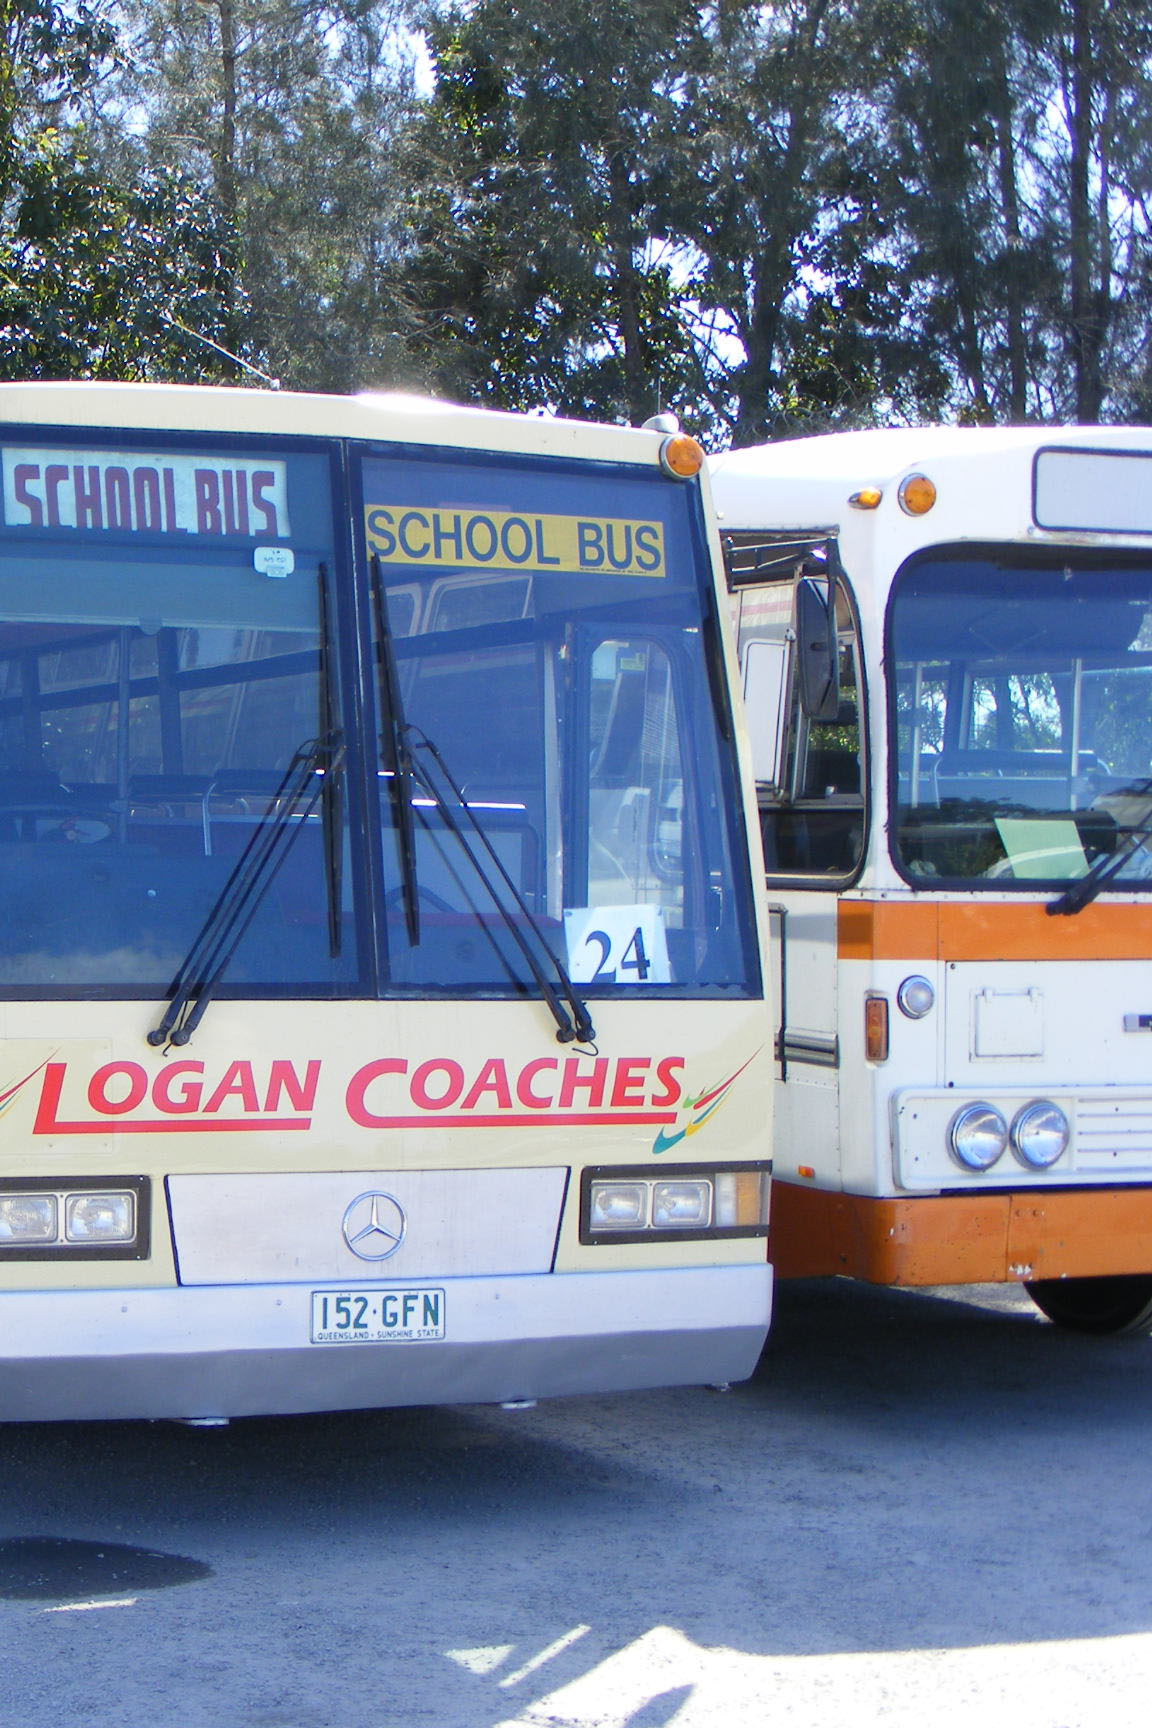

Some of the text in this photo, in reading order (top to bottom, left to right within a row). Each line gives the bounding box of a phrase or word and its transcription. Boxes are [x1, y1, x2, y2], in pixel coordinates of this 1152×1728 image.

[14, 464, 278, 536] SCHOOL BUS
[367, 510, 661, 571] SCHOOL BUS
[585, 927, 651, 984] 24
[32, 1057, 686, 1135] LOGAN COACHES
[318, 1328, 440, 1340] QUEENSLAND SUNSHINE STATE
